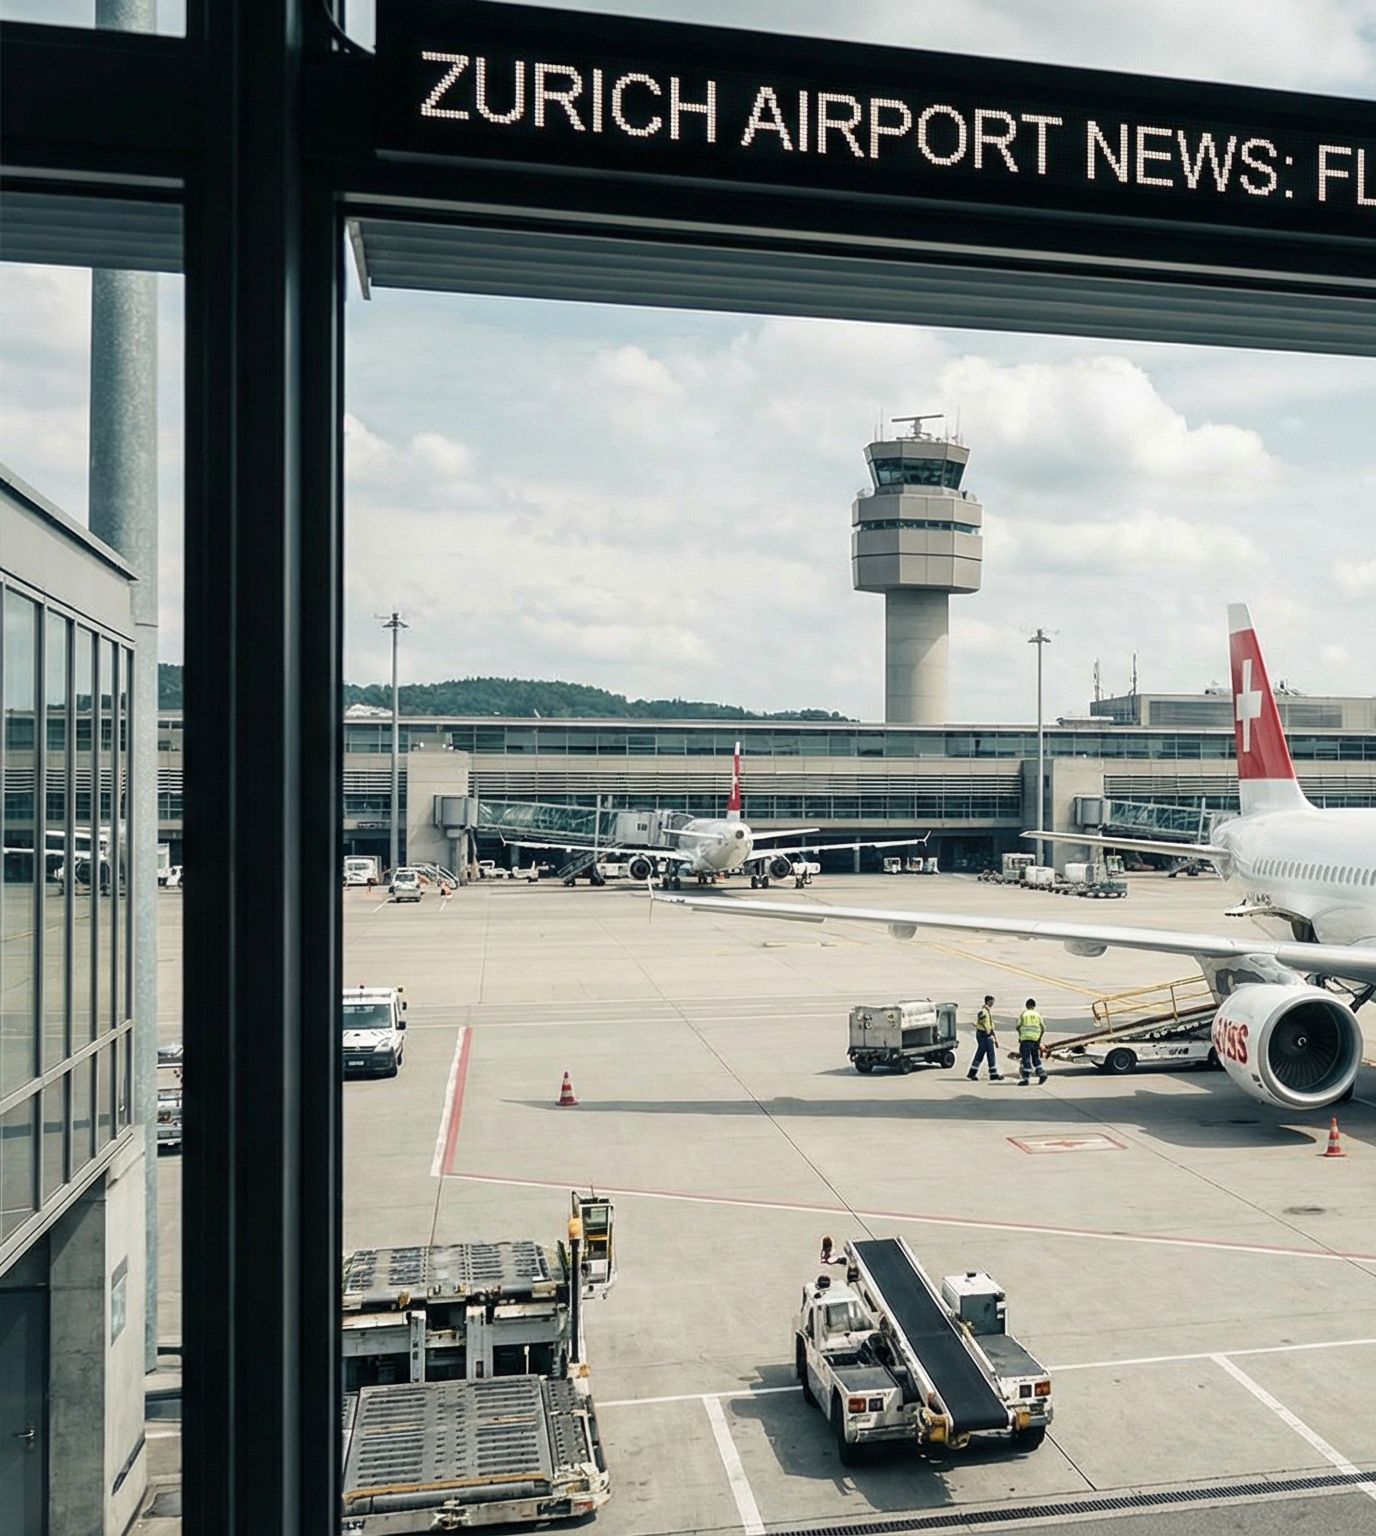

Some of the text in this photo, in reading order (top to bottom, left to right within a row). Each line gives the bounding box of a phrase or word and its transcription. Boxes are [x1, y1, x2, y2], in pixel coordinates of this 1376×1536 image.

[420, 51, 717, 143] ZURICH
[740, 86, 1063, 175] AIRPORT
[1087, 120, 1293, 199] NEWS:
